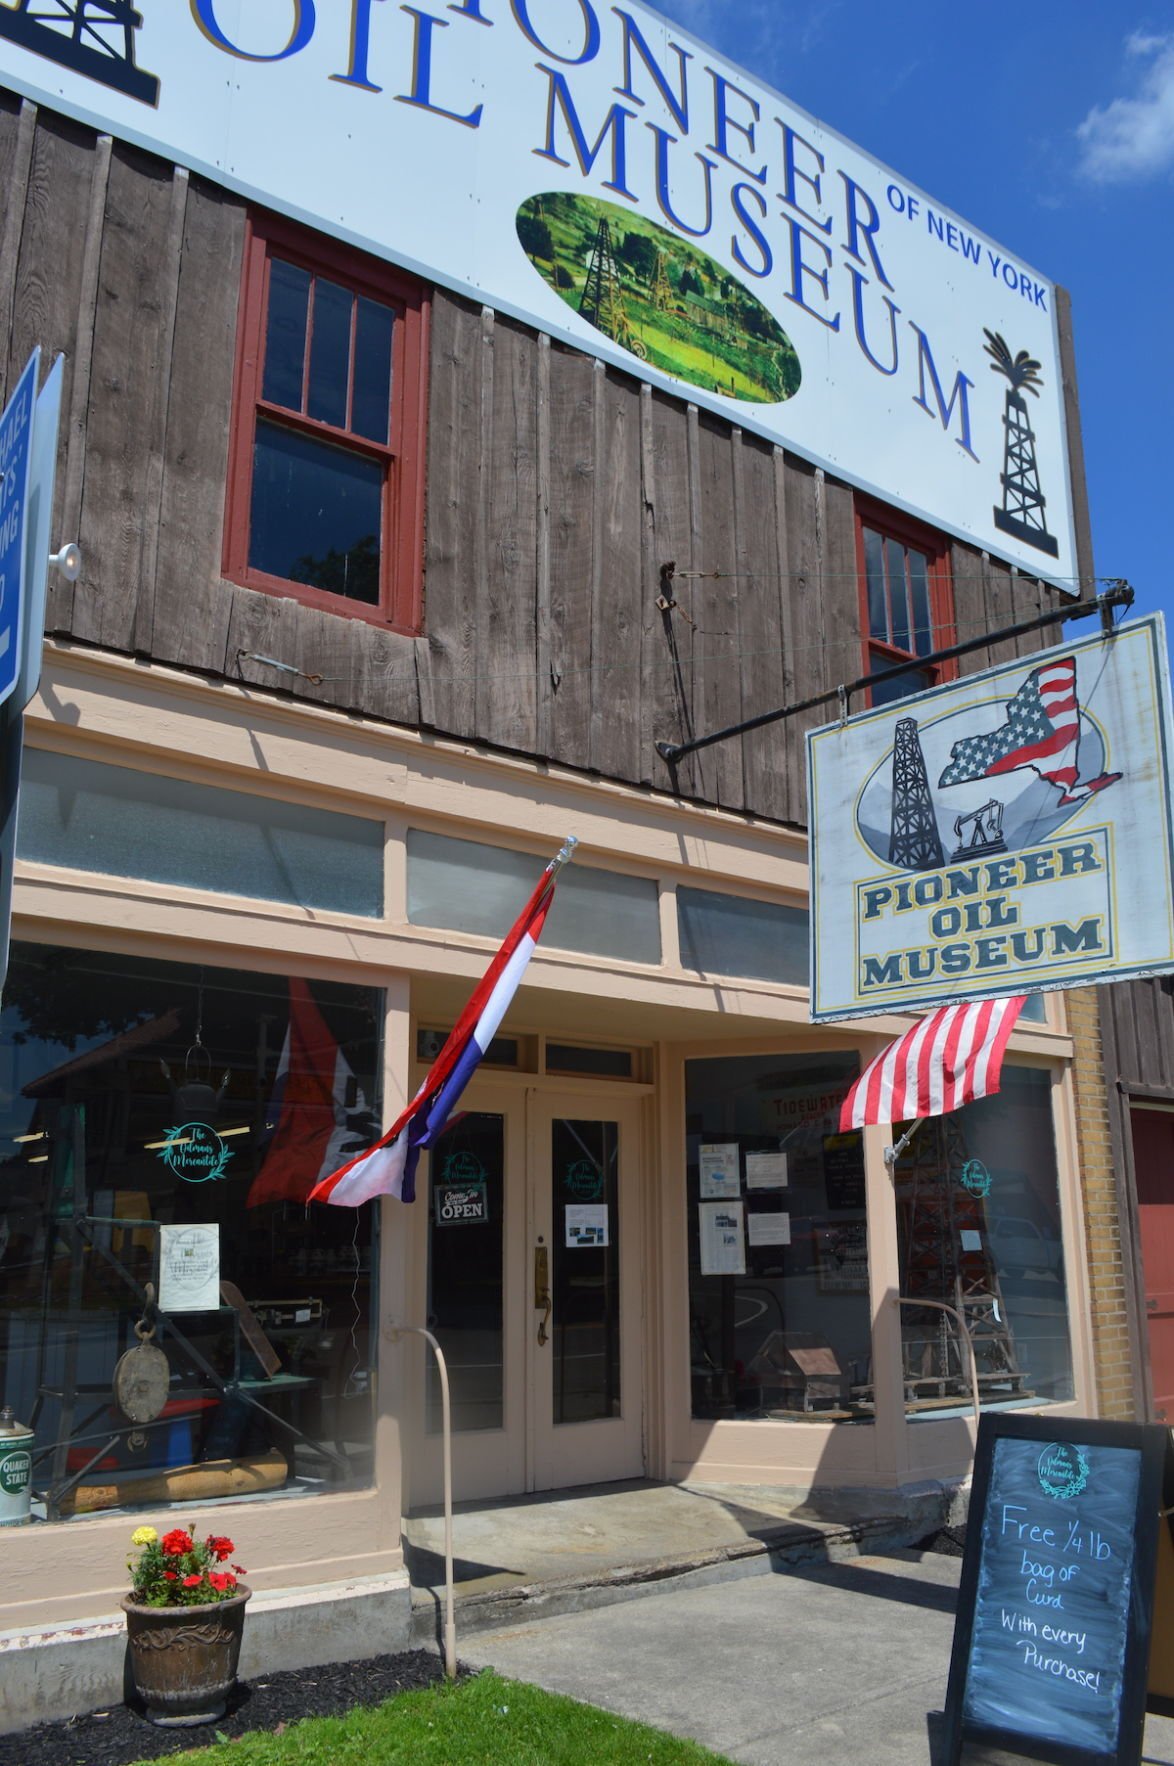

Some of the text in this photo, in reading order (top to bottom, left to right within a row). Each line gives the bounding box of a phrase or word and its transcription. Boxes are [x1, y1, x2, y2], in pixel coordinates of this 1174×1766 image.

[447, 0, 895, 292] ONEER
[531, 62, 981, 464] MUSEUM
[887, 184, 1048, 313] OF NEW YORK
[863, 841, 1102, 919] PIONEER
[931, 896, 1019, 938] OIL
[863, 918, 1102, 987] MUSEUM
[441, 1203, 482, 1219] OPEN
[445, 1191, 465, 1202] Come
[3, 1460, 29, 1473] QUAKER
[6, 1472, 28, 1485] STATE
[1002, 1504, 1056, 1547] Free
[1089, 1530, 1111, 1560] lb
[1020, 1549, 1081, 1588] bag of
[1025, 1578, 1065, 1609] Curd
[1001, 1608, 1087, 1655] With every
[1016, 1640, 1100, 1694] Purchase!
